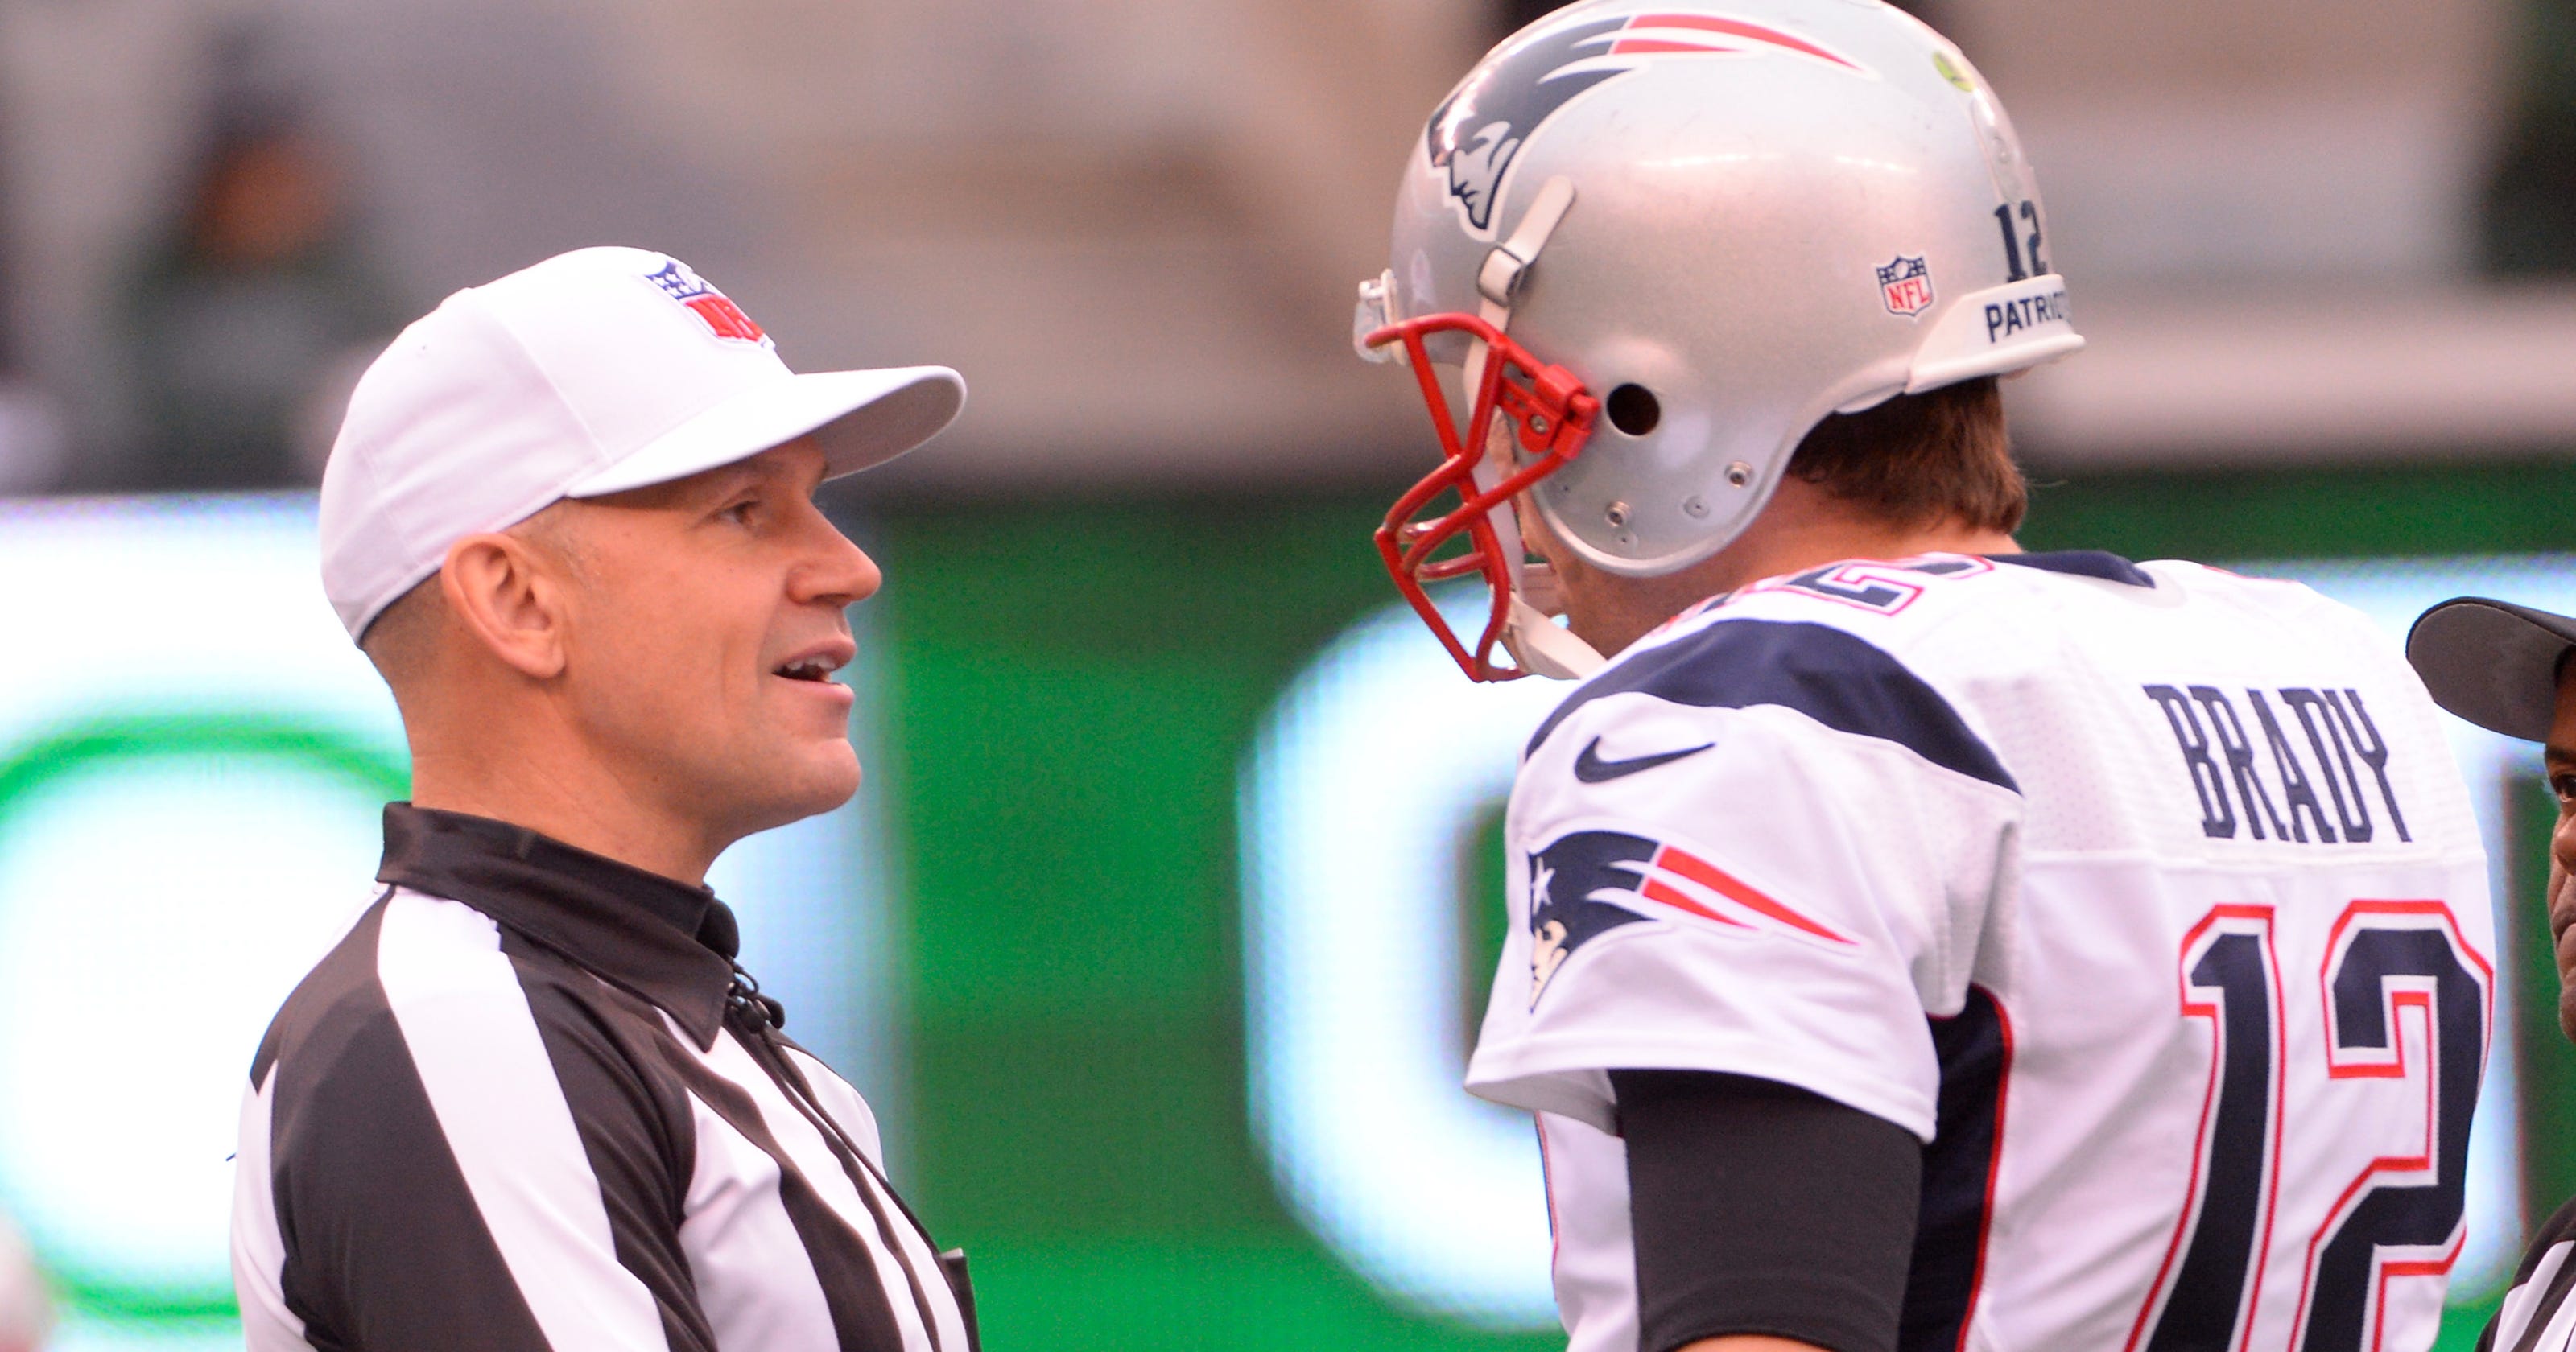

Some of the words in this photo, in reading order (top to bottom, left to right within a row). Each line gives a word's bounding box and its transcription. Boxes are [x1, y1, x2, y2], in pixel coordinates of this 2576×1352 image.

[1886, 278, 1931, 310] NFL
[1994, 200, 2047, 282] 12
[2143, 685, 2412, 843] BRADY
[2128, 900, 2494, 1352] 12
